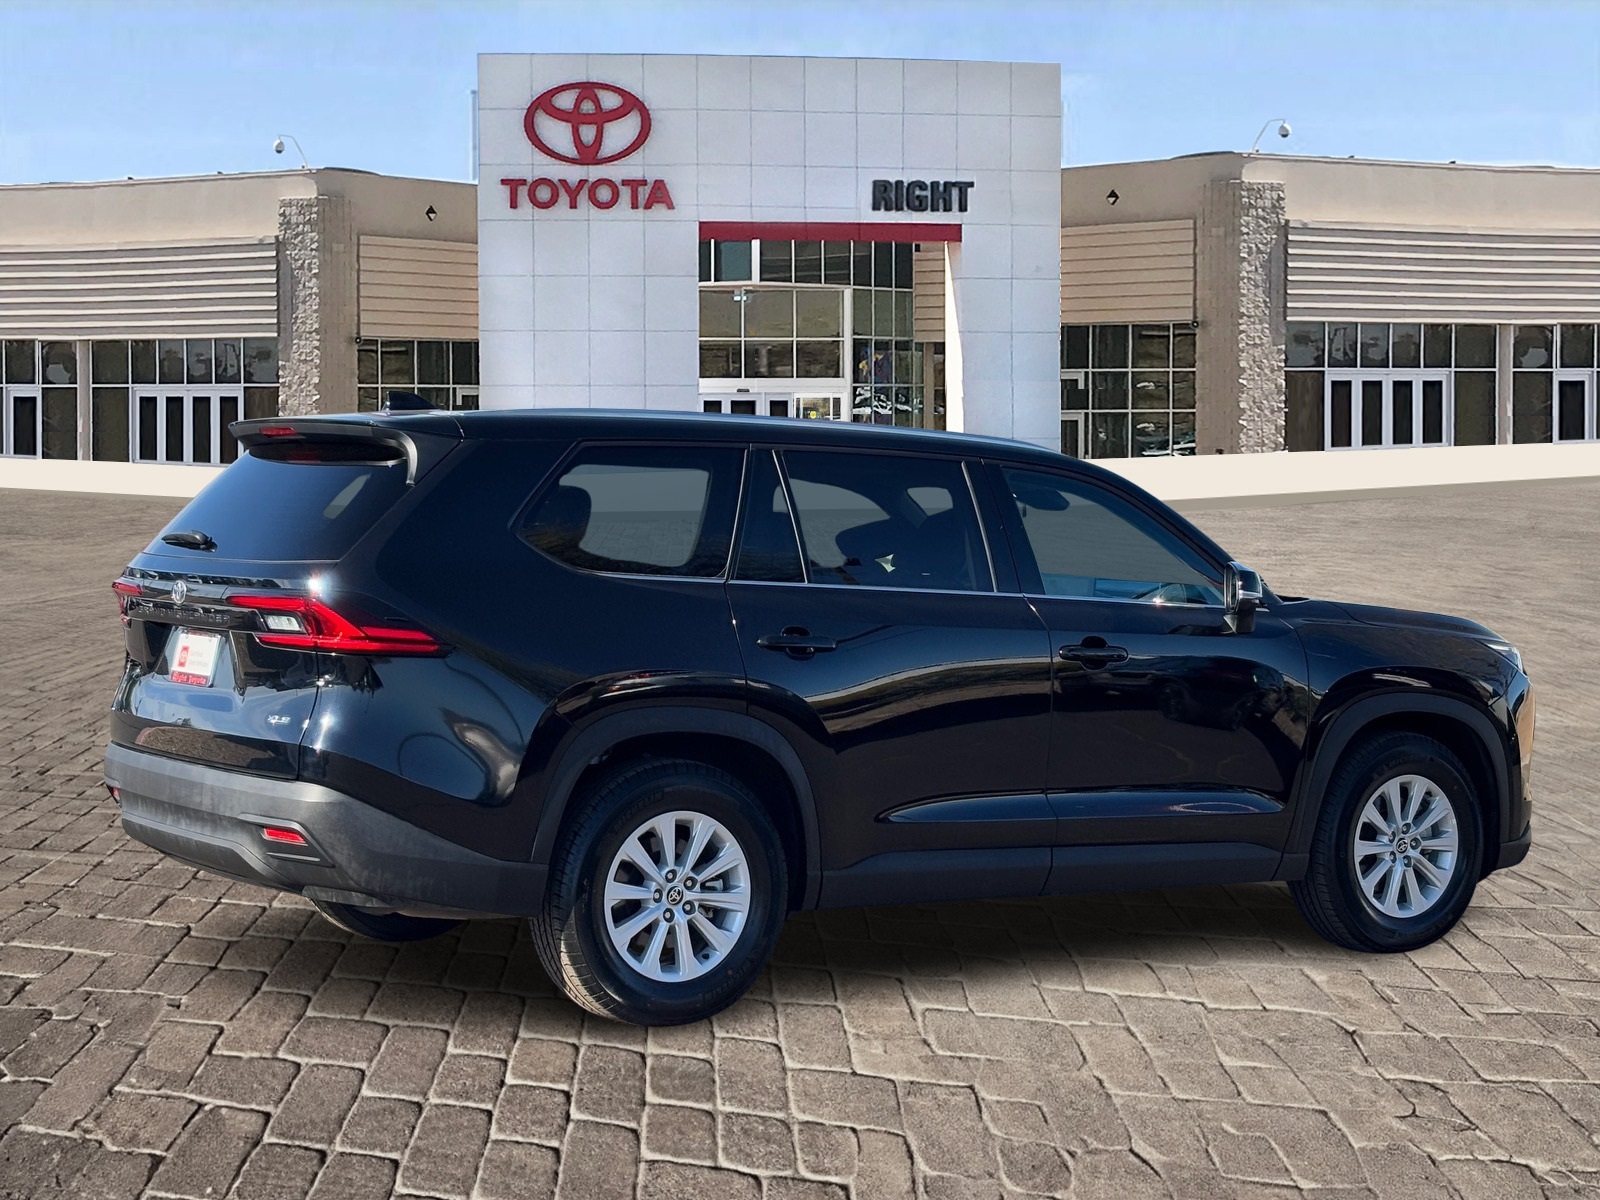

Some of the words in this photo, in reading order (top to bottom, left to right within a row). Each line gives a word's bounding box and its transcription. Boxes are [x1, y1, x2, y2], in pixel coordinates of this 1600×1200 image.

[500, 178, 675, 210] TOYOTA
[872, 180, 975, 212] RIGHT
[188, 674, 207, 686] Toyota
